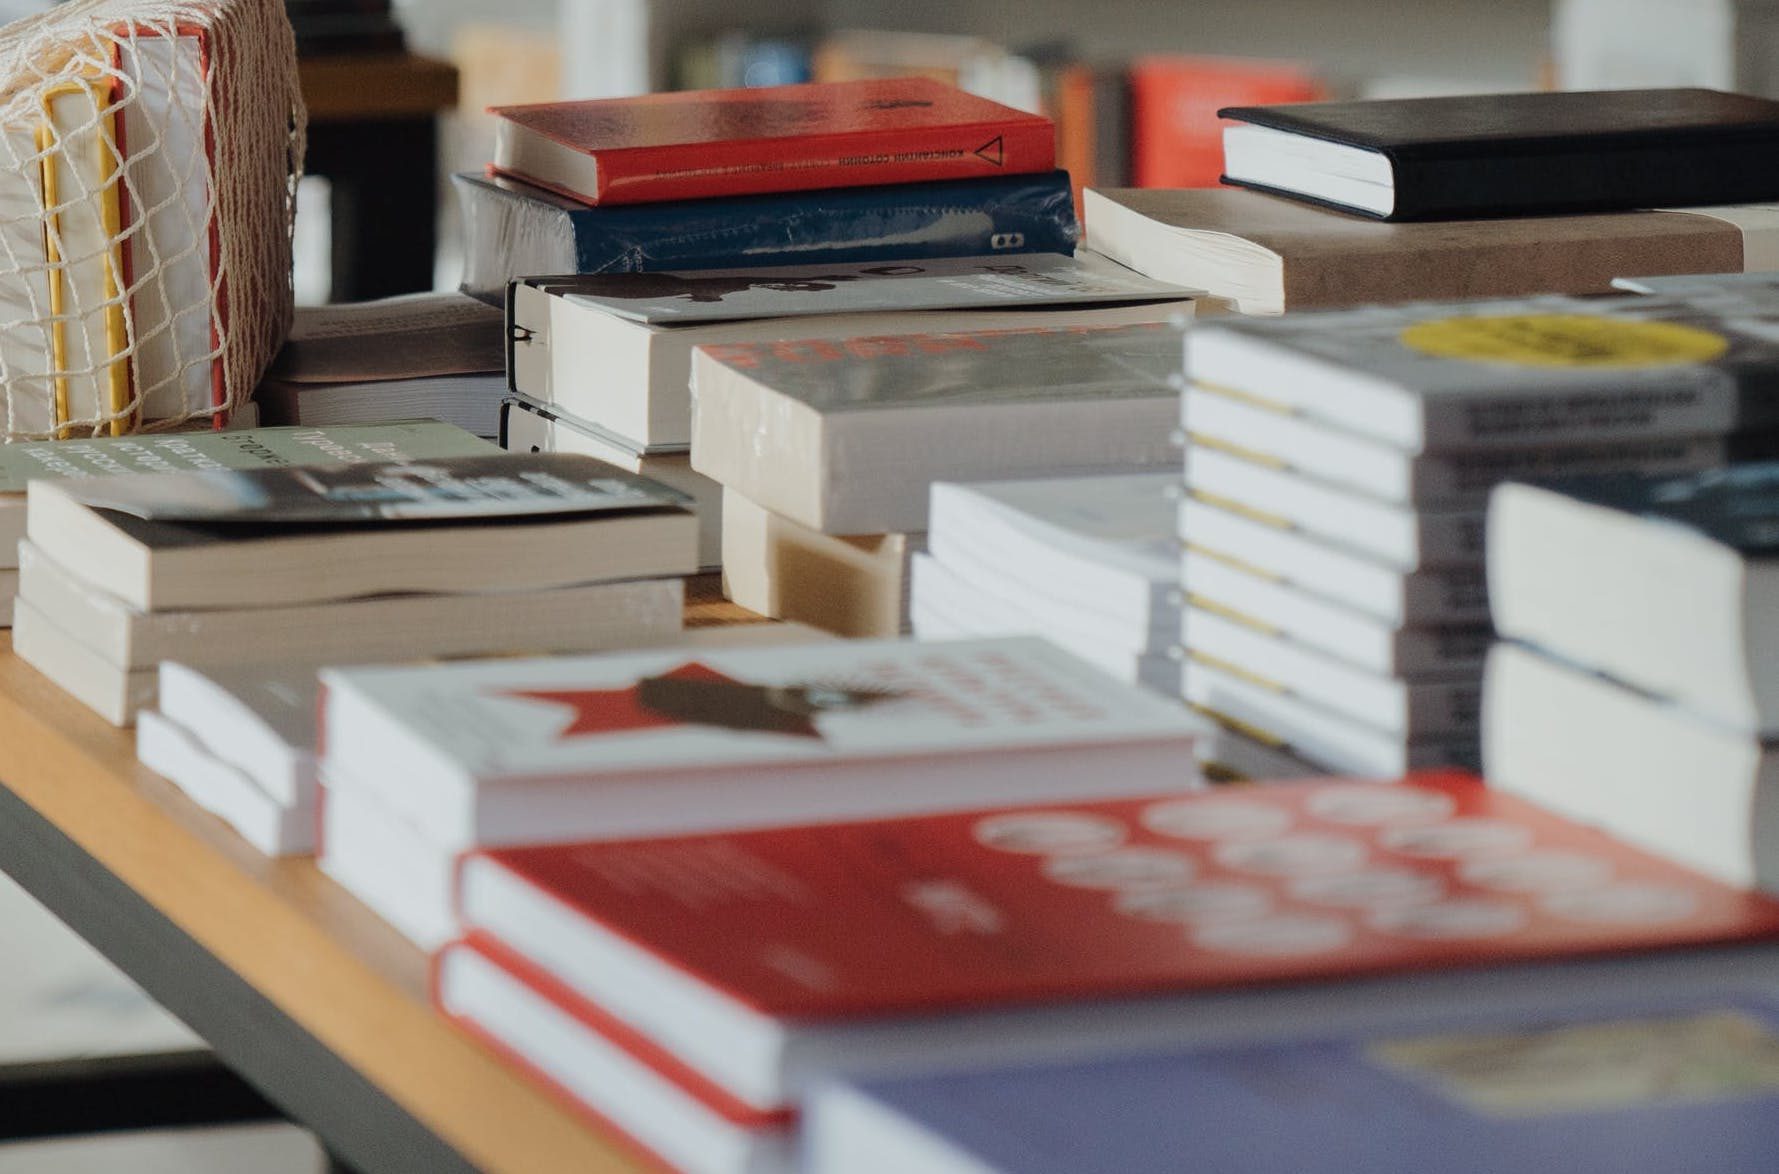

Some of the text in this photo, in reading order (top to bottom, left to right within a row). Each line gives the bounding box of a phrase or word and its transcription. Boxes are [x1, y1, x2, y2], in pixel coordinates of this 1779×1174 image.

[839, 149, 964, 167] КОНСТАНТИН СОТОНИН
[222, 435, 292, 469] Вторже
